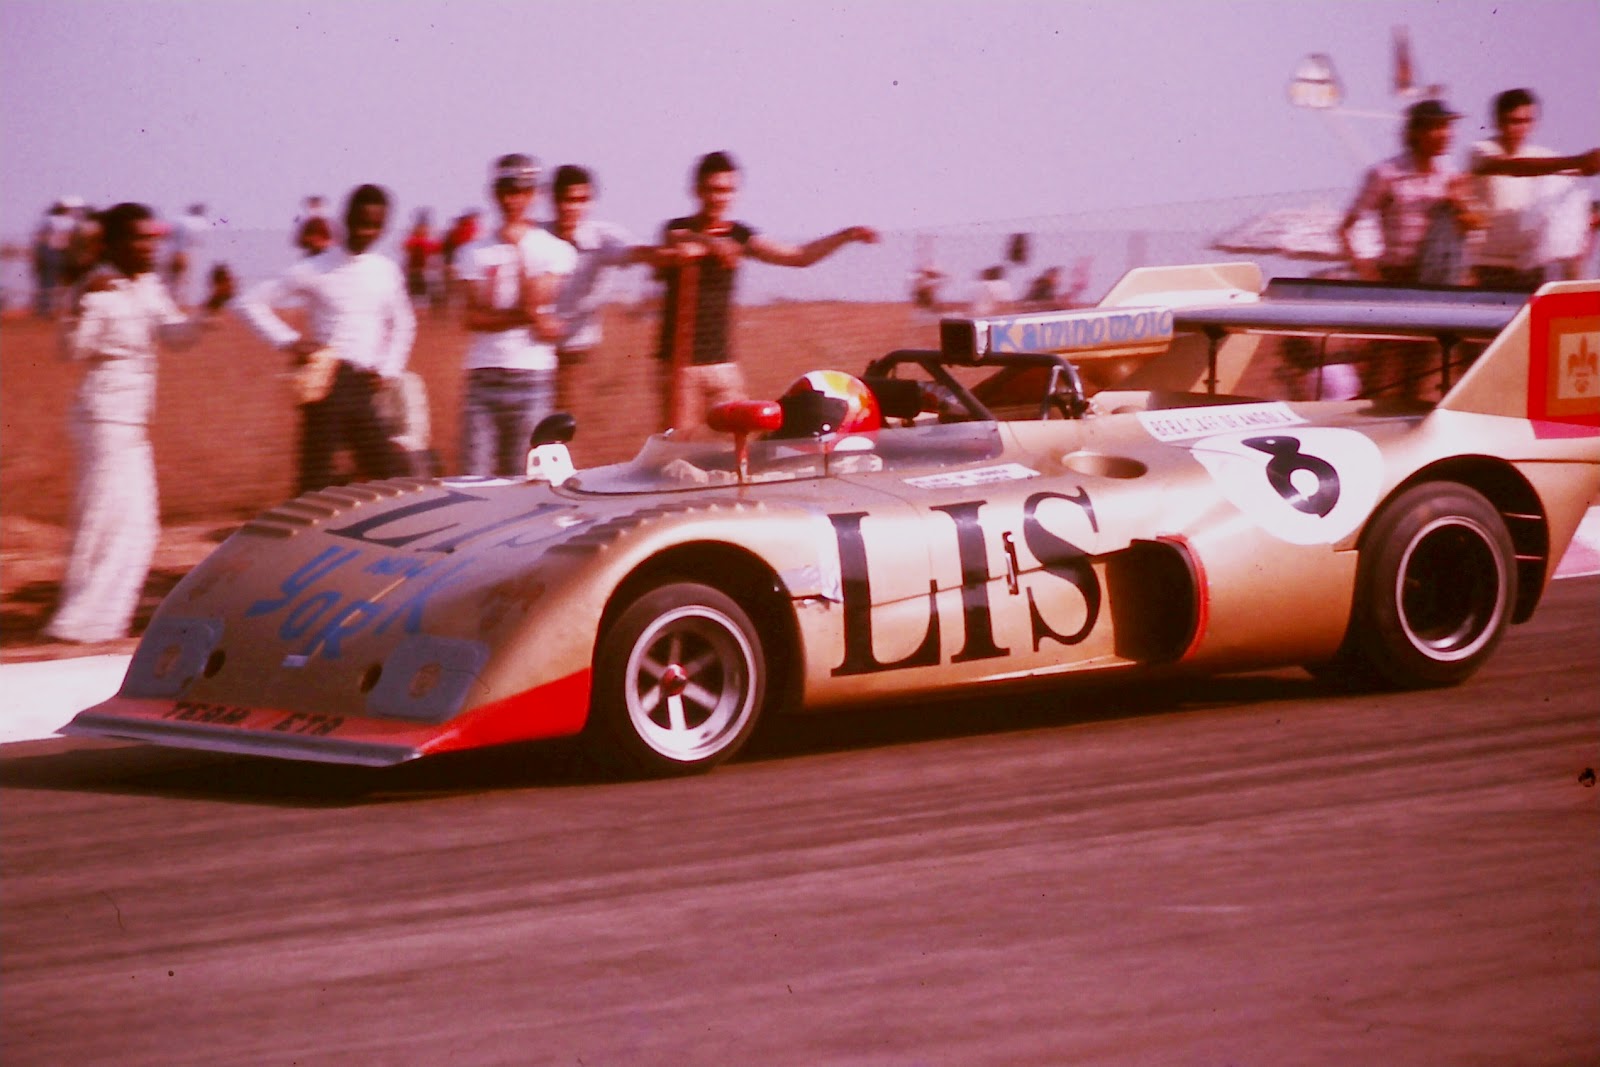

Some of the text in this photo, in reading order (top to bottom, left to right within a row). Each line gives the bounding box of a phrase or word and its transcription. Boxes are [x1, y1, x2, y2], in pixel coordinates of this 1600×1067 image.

[1239, 410, 1293, 425] ANGOA
[1241, 436, 1340, 518] 8
[830, 486, 1100, 677] LIS
[162, 701, 251, 725] TEAM
